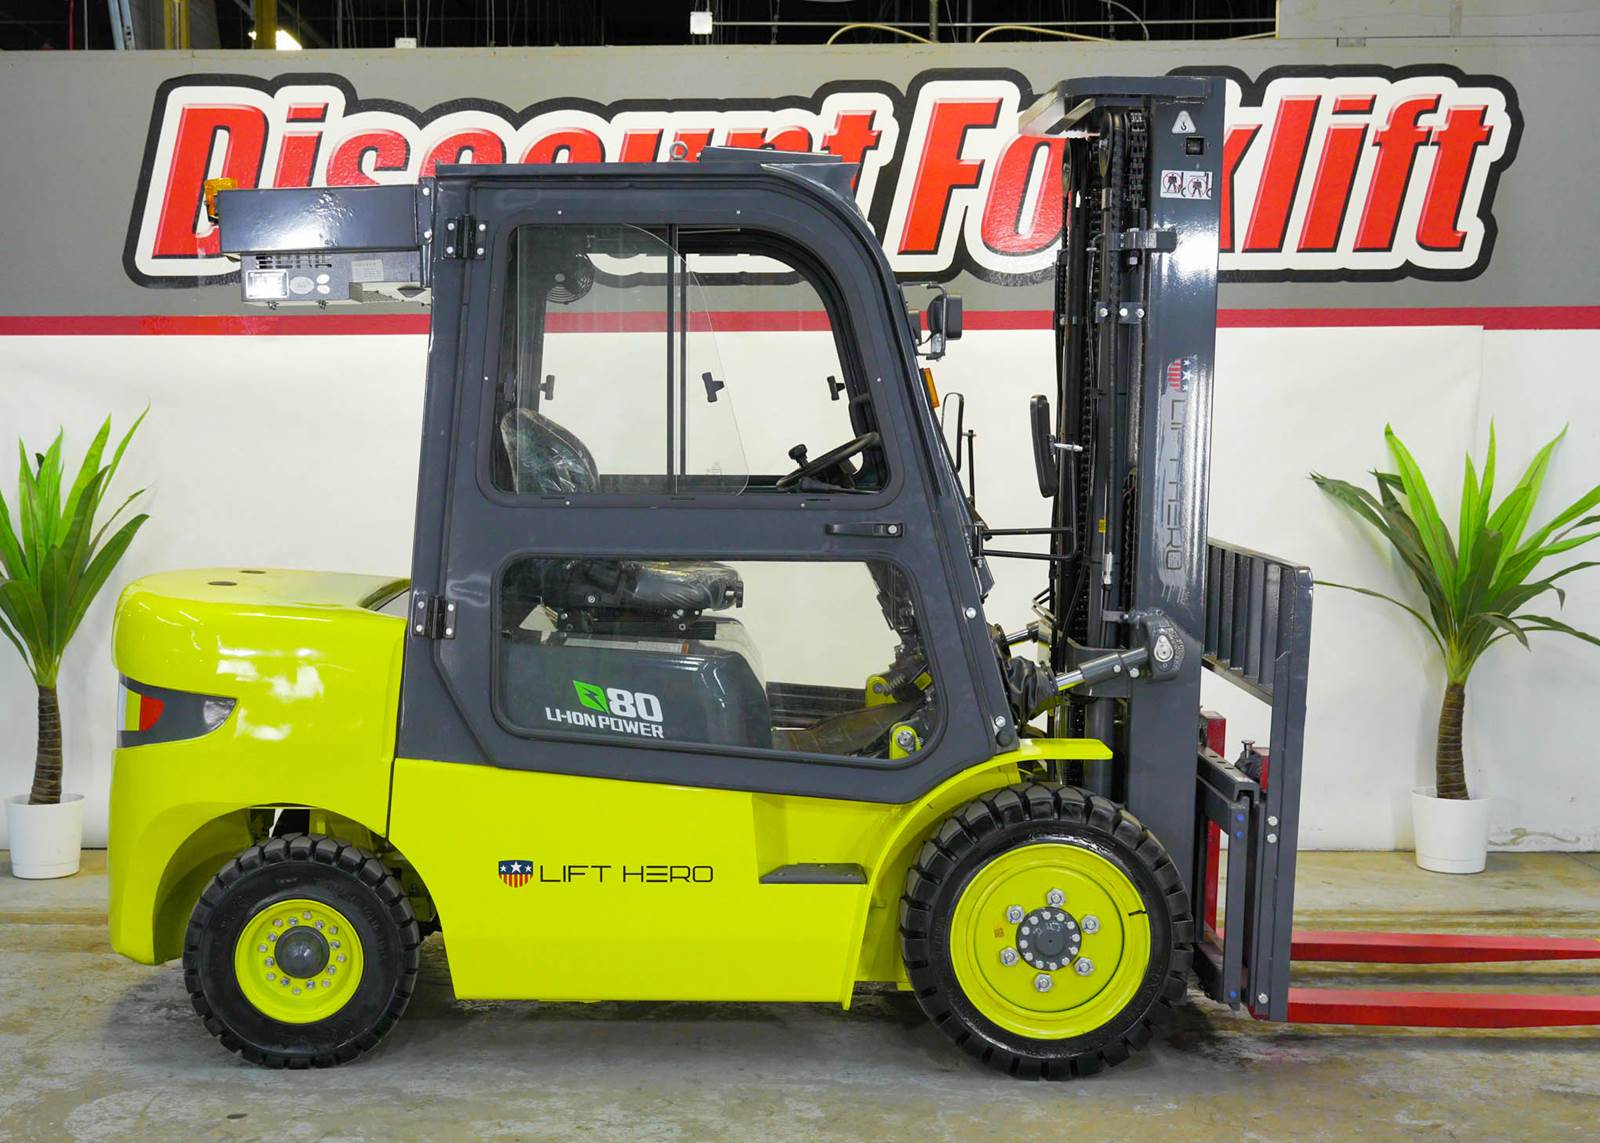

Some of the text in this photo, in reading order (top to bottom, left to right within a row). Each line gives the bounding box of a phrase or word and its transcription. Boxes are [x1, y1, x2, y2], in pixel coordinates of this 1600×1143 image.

[152, 93, 1494, 259] Dist Folift
[1165, 482, 1184, 570] HERO
[545, 707, 665, 739] LI-ION POWER
[606, 688, 664, 723] 80
[540, 865, 714, 883] LIFT HERO
